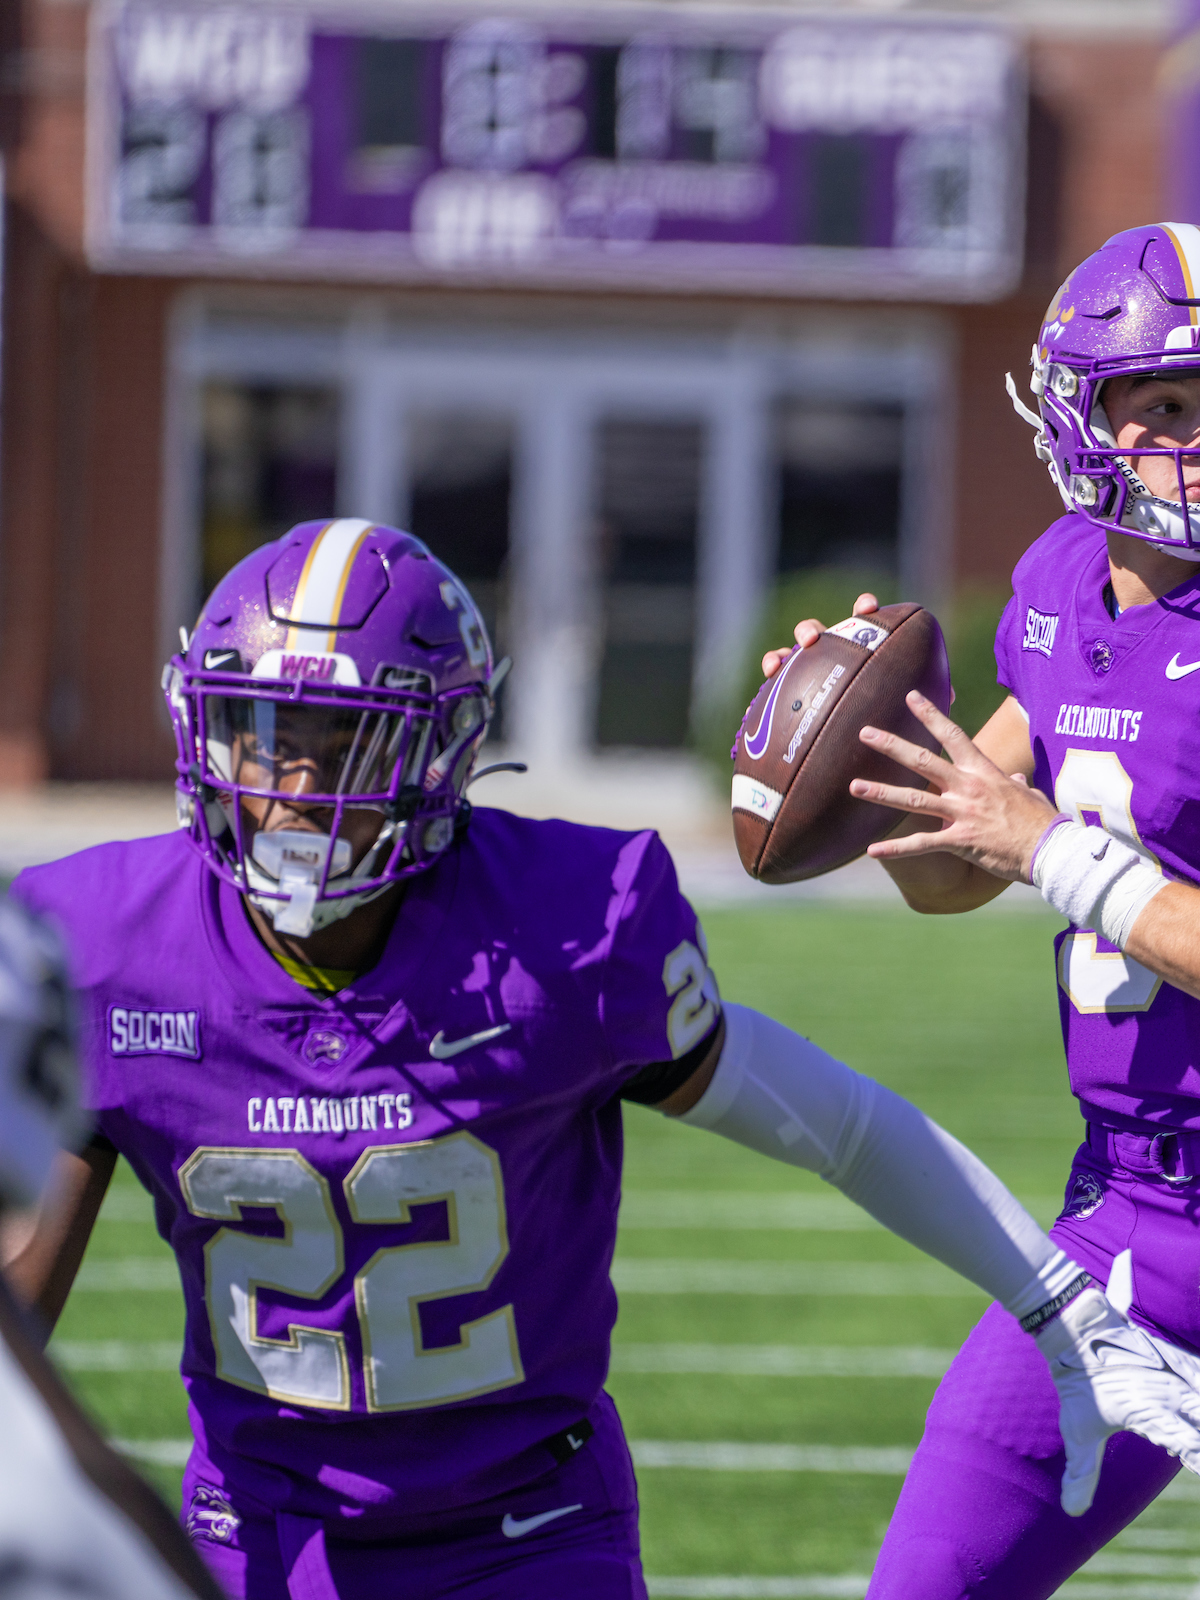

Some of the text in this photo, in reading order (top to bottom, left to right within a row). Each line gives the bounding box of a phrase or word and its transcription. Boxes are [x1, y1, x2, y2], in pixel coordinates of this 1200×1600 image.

[1022, 608, 1059, 656] SOCON
[280, 655, 335, 680] WCU
[783, 707, 818, 764] VAPOR
[1055, 703, 1143, 742] CATAMOUNTS
[111, 1007, 197, 1055] SOCON
[248, 1093, 413, 1133] CATAMOUNTS
[177, 1130, 525, 1414] 22
[566, 1433, 584, 1450] L
